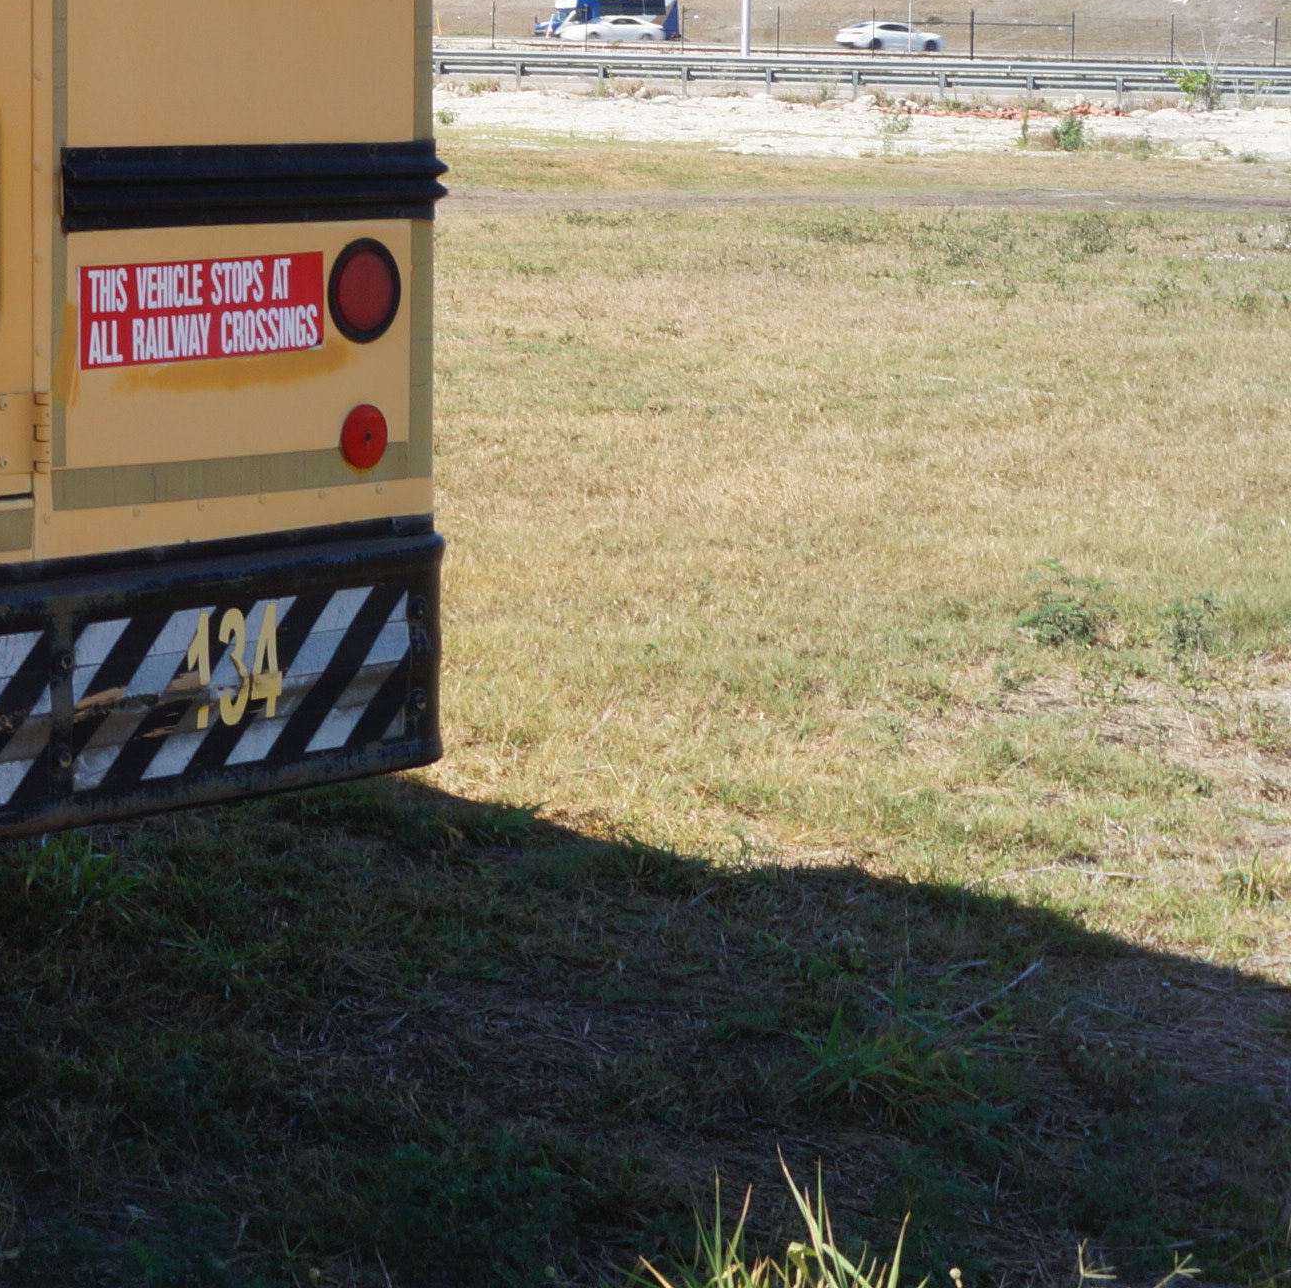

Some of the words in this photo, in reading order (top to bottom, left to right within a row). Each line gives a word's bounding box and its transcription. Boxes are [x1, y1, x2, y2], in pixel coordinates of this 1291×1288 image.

[88, 267, 127, 313] THIS
[136, 263, 203, 310] VEHICLE
[210, 259, 264, 305] STOPS
[272, 257, 291, 300] AT
[88, 320, 123, 365] ALL
[132, 313, 211, 361] RAILWAY
[220, 304, 318, 355] CROSSINGS
[187, 601, 283, 728] 134
